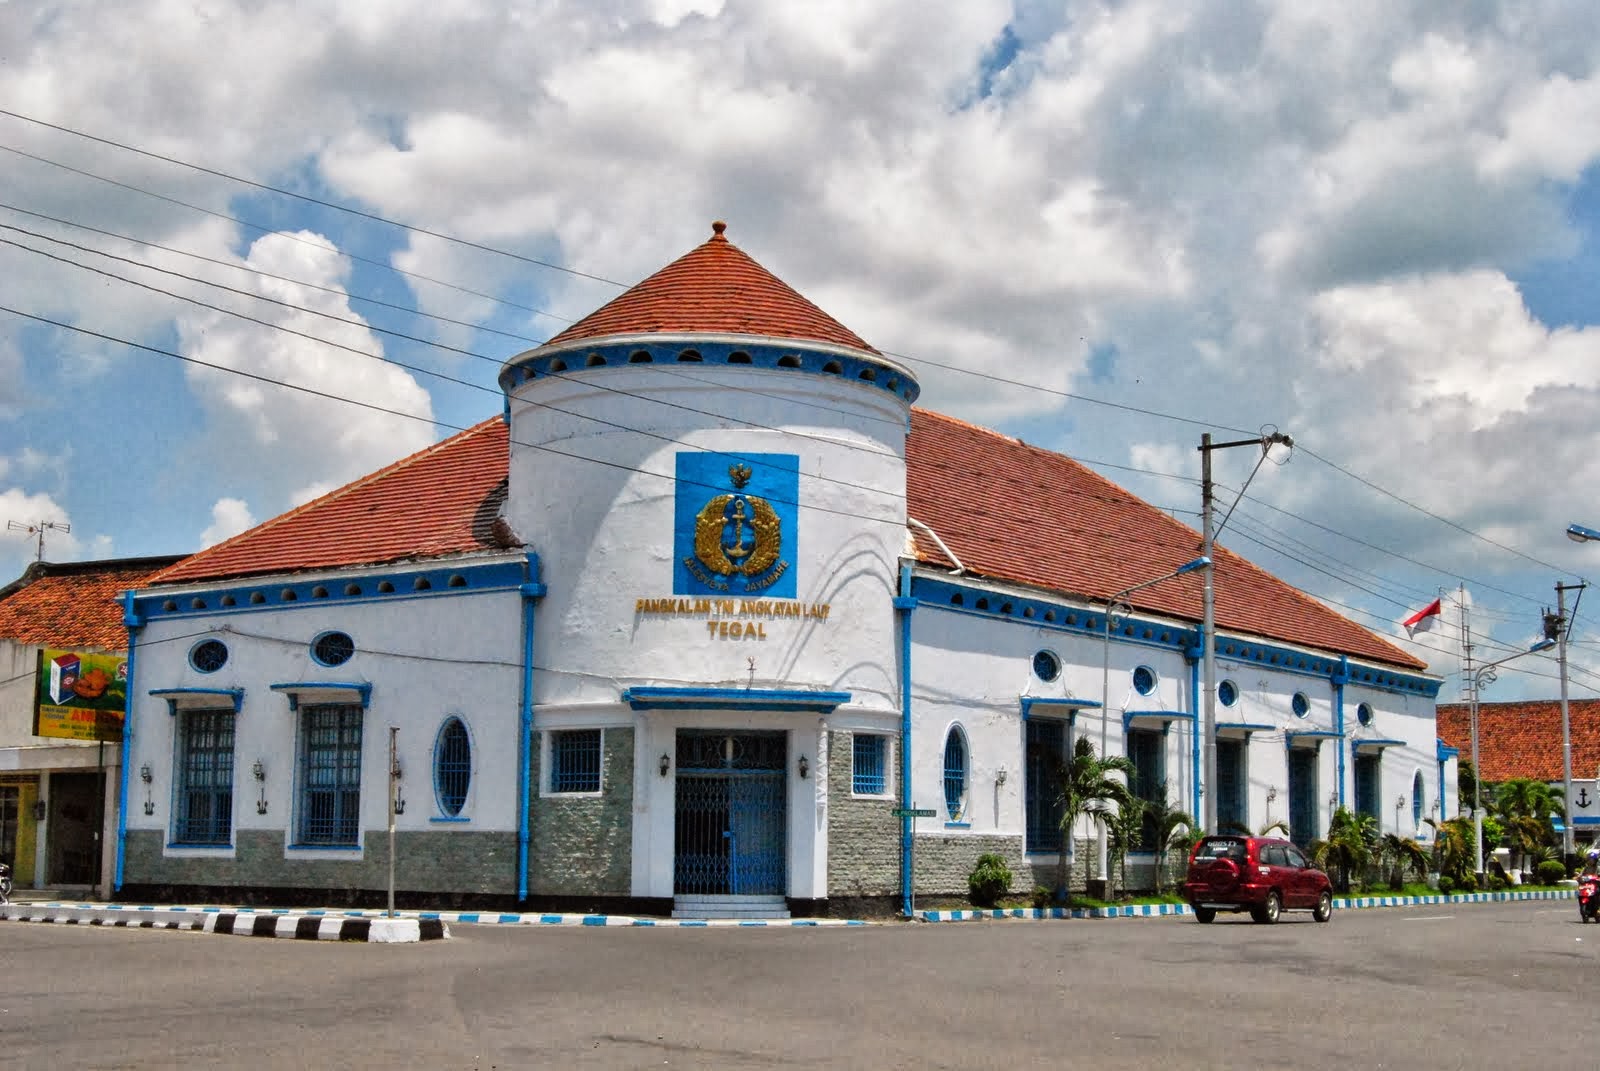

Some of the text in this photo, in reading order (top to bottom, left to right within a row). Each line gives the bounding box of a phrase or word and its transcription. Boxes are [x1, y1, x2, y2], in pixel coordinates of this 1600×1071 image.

[636, 599, 711, 613] PANGKALAN
[739, 601, 801, 616] ANGKATAN
[803, 603, 831, 619] LAUT
[707, 621, 766, 637] TEGAL
